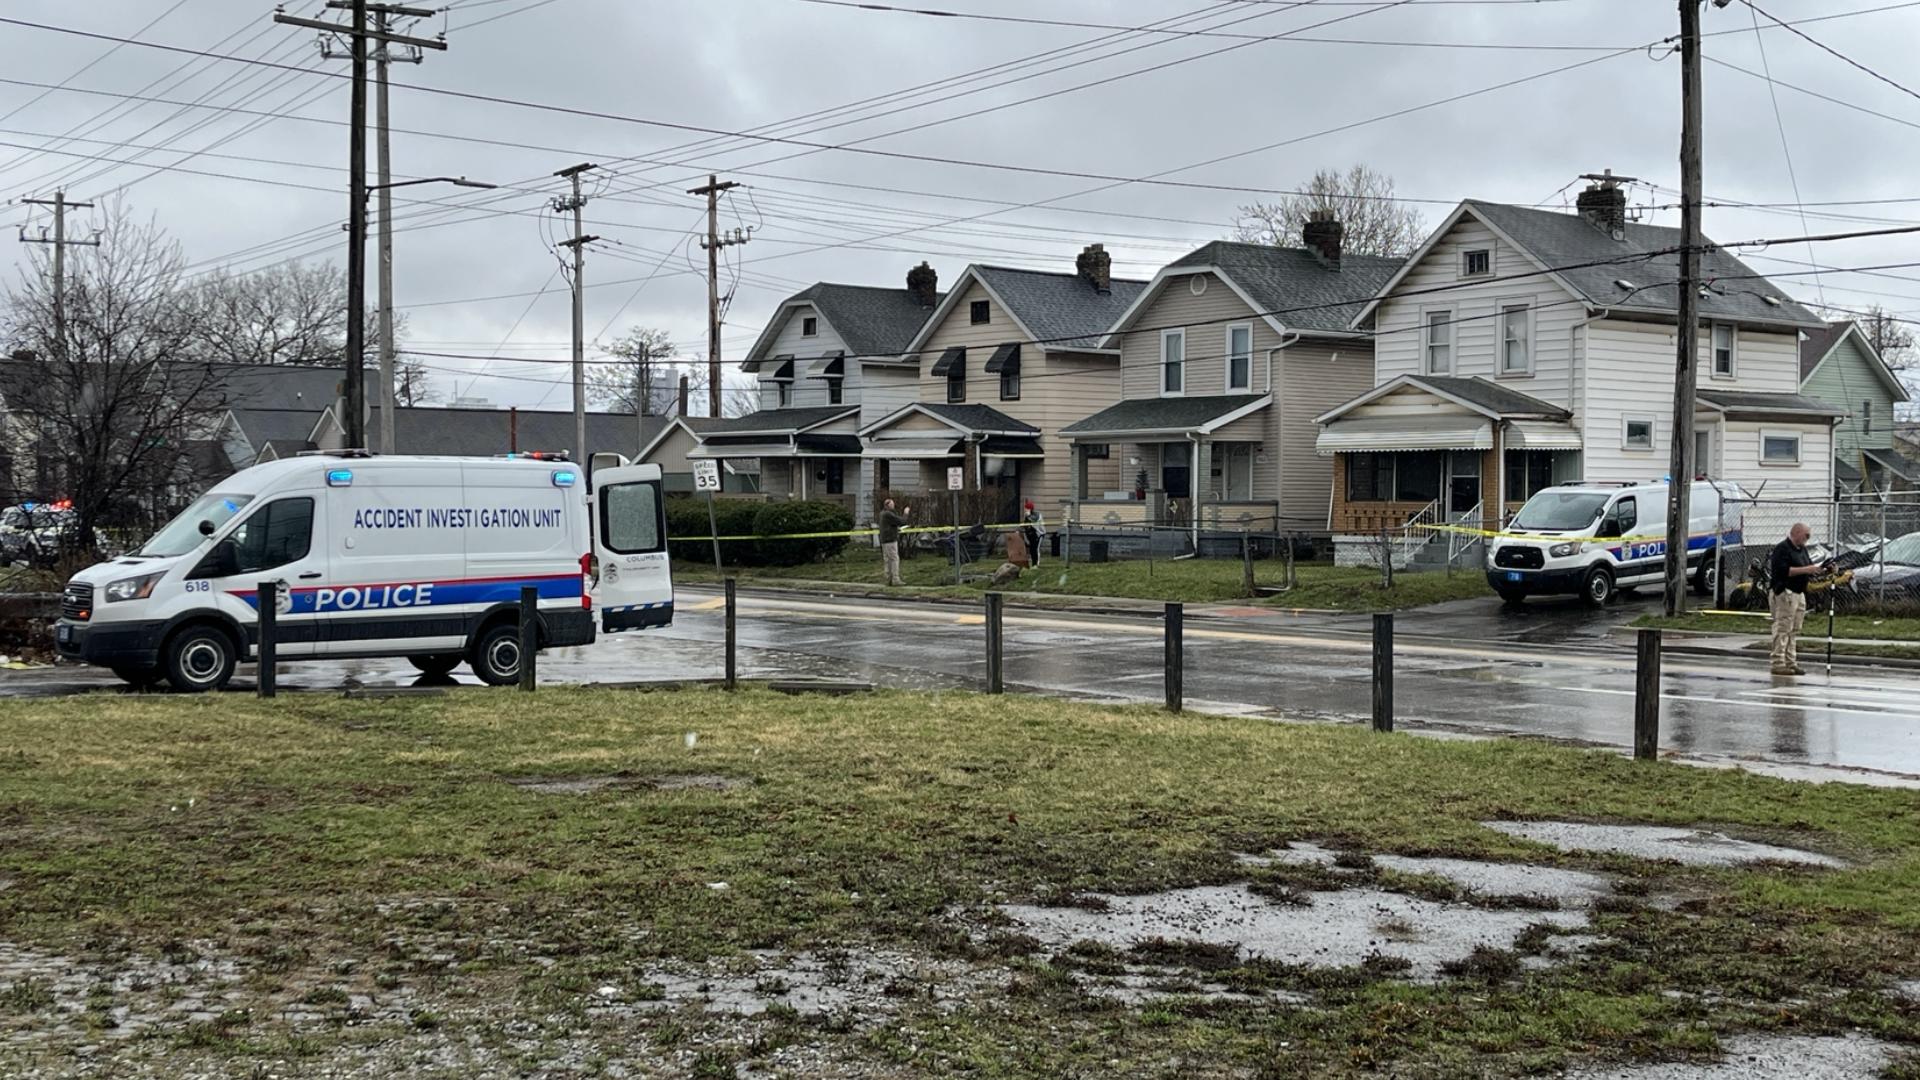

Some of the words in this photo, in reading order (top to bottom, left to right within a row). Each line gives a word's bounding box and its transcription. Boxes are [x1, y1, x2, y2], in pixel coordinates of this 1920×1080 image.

[698, 475, 717, 488] 35
[354, 509, 422, 529] ACCIDENT
[427, 508, 530, 528] INVESTIGATION
[534, 508, 561, 528] UNIT
[1639, 542, 1664, 557] POL
[185, 581, 210, 593] 618
[315, 583, 434, 611] POLICE
